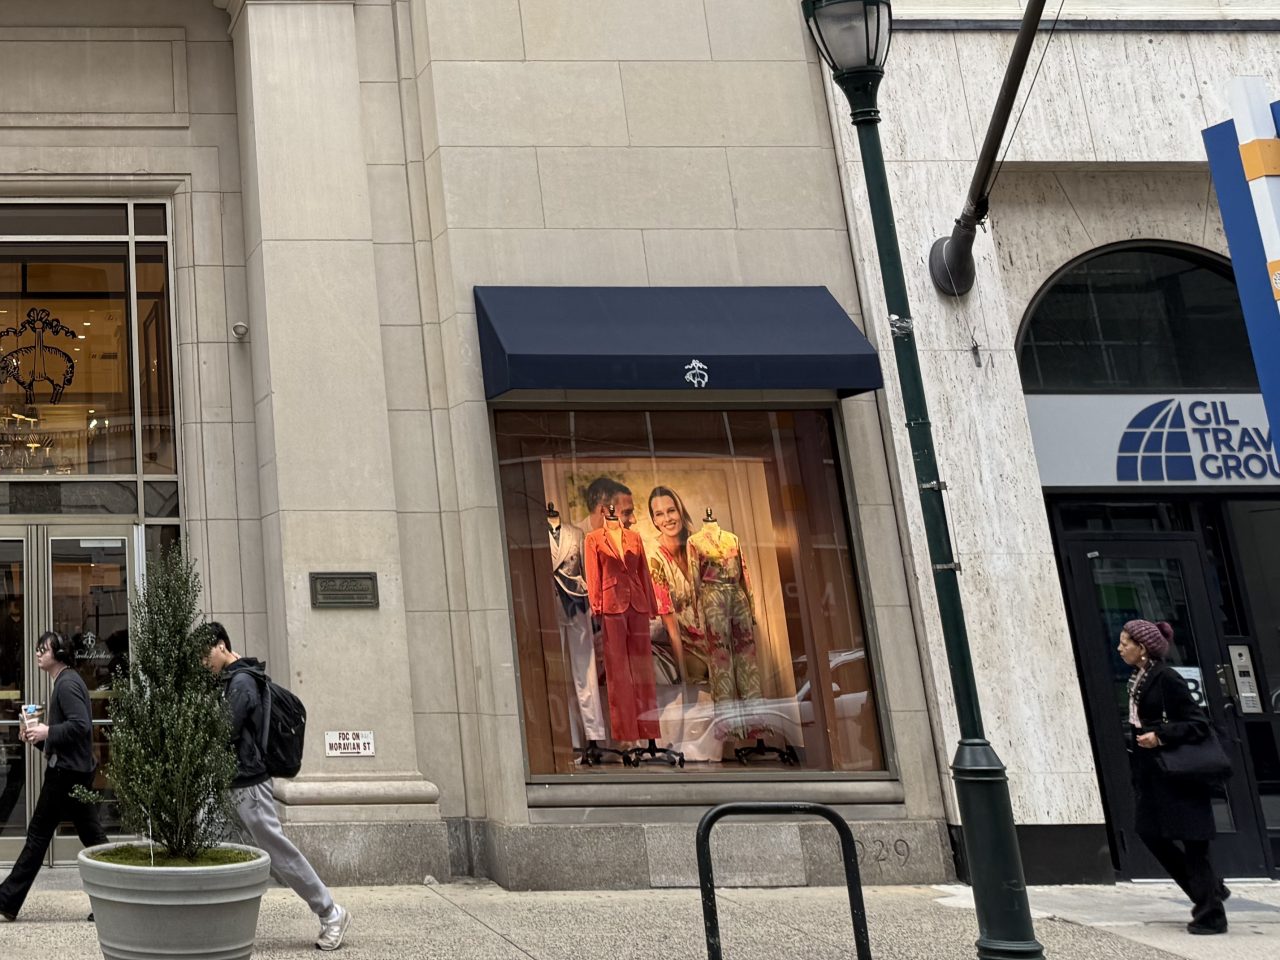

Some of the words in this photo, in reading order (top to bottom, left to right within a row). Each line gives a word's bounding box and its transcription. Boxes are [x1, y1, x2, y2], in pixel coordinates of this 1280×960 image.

[1188, 401, 1239, 426] GIL
[339, 733, 350, 741] FDC
[352, 733, 360, 741] ON
[329, 742, 360, 751] MORAVIAN
[363, 742, 371, 751] ST
